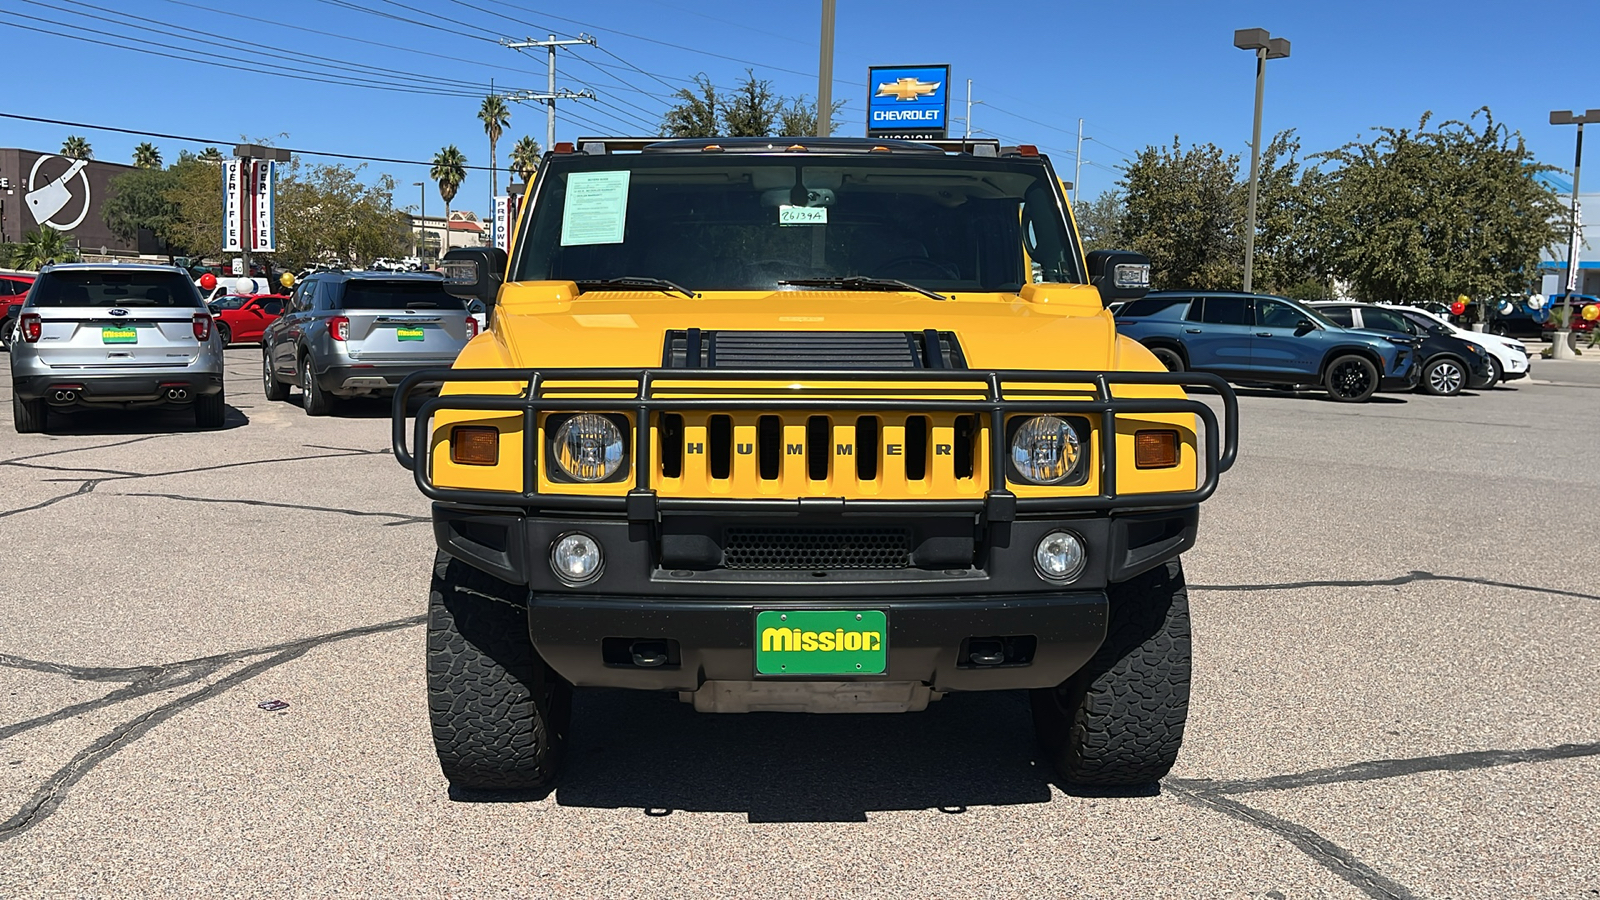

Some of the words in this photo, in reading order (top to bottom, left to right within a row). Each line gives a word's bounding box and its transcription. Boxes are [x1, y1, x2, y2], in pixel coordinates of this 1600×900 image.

[874, 110, 940, 120] CHEVROLET
[229, 165, 237, 246] CERTIFIED
[260, 165, 268, 246] CERTIFIED
[781, 211, 822, 221] 26139A
[687, 442, 952, 456] HUMMER
[762, 627, 880, 652] Mission
